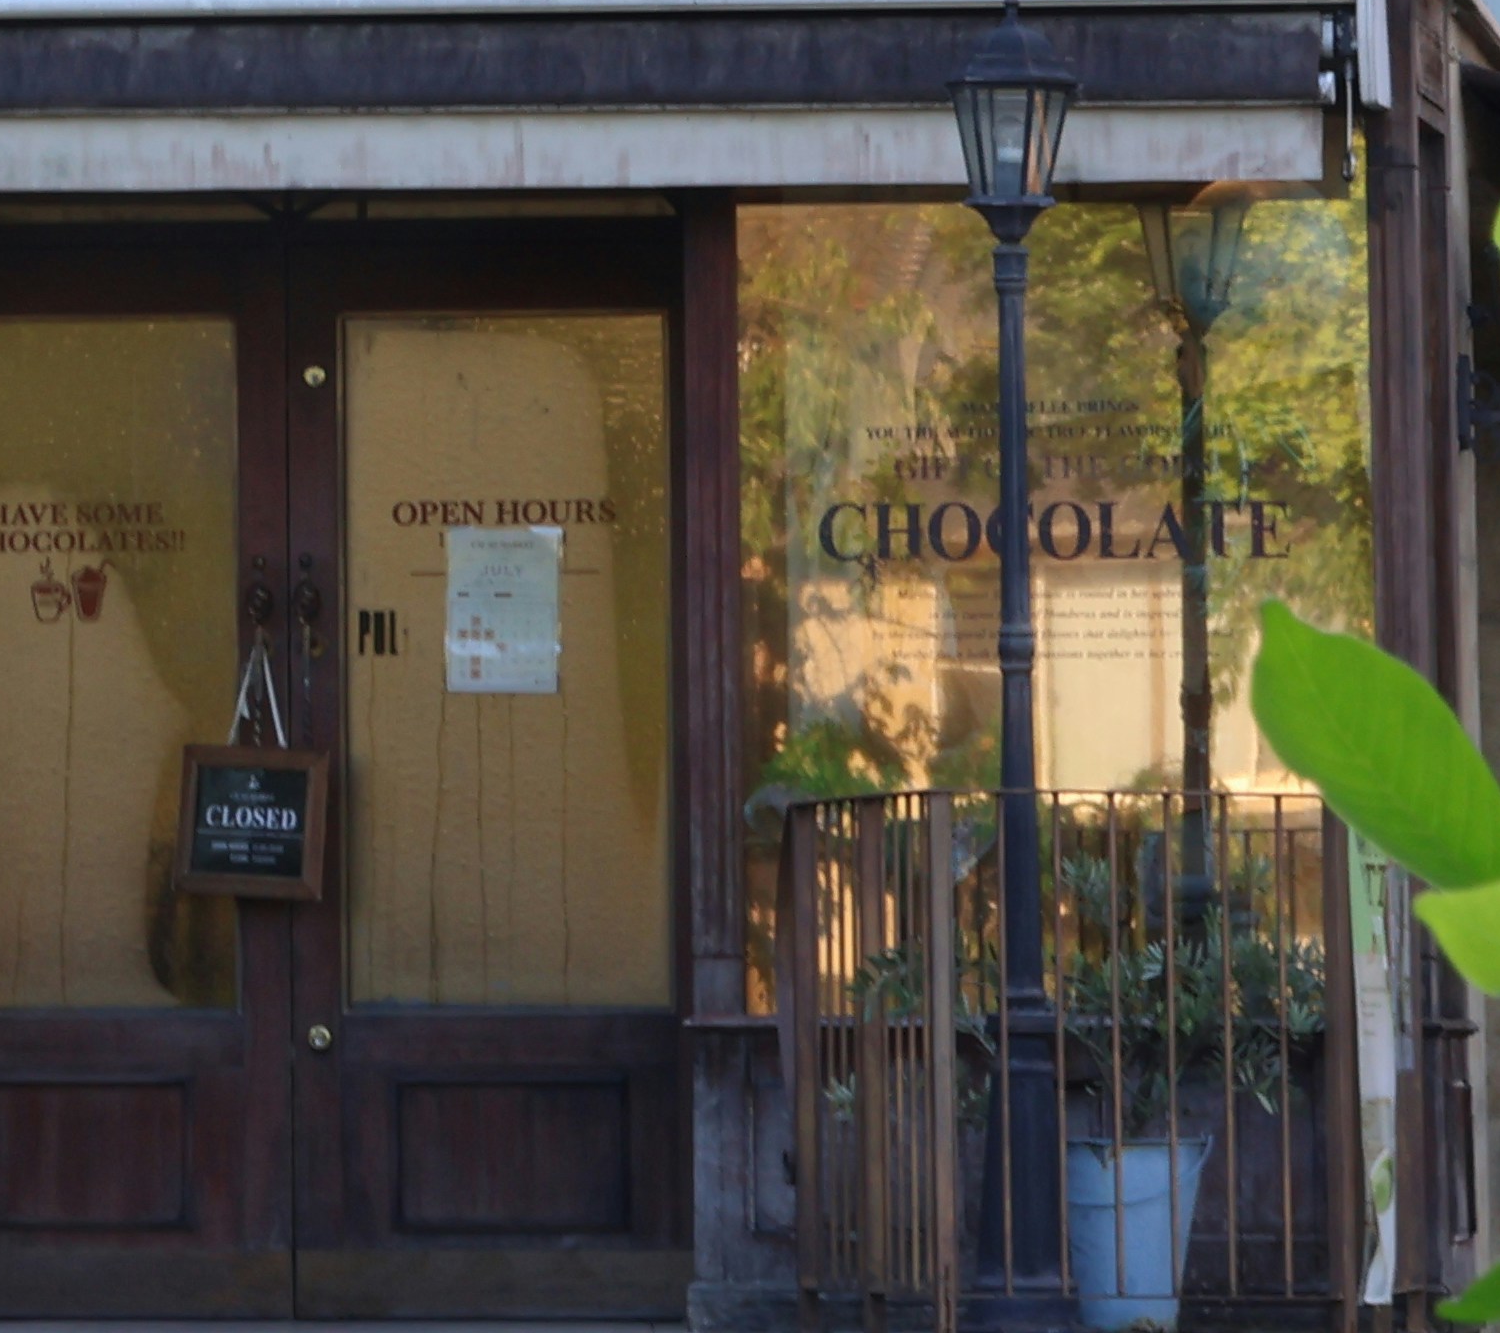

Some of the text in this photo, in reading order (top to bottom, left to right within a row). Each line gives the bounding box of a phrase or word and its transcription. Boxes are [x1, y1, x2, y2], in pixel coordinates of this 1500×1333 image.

[75, 501, 164, 525] SOME
[392, 497, 618, 527] OPEN HOURS
[205, 804, 298, 830] CLOSED
